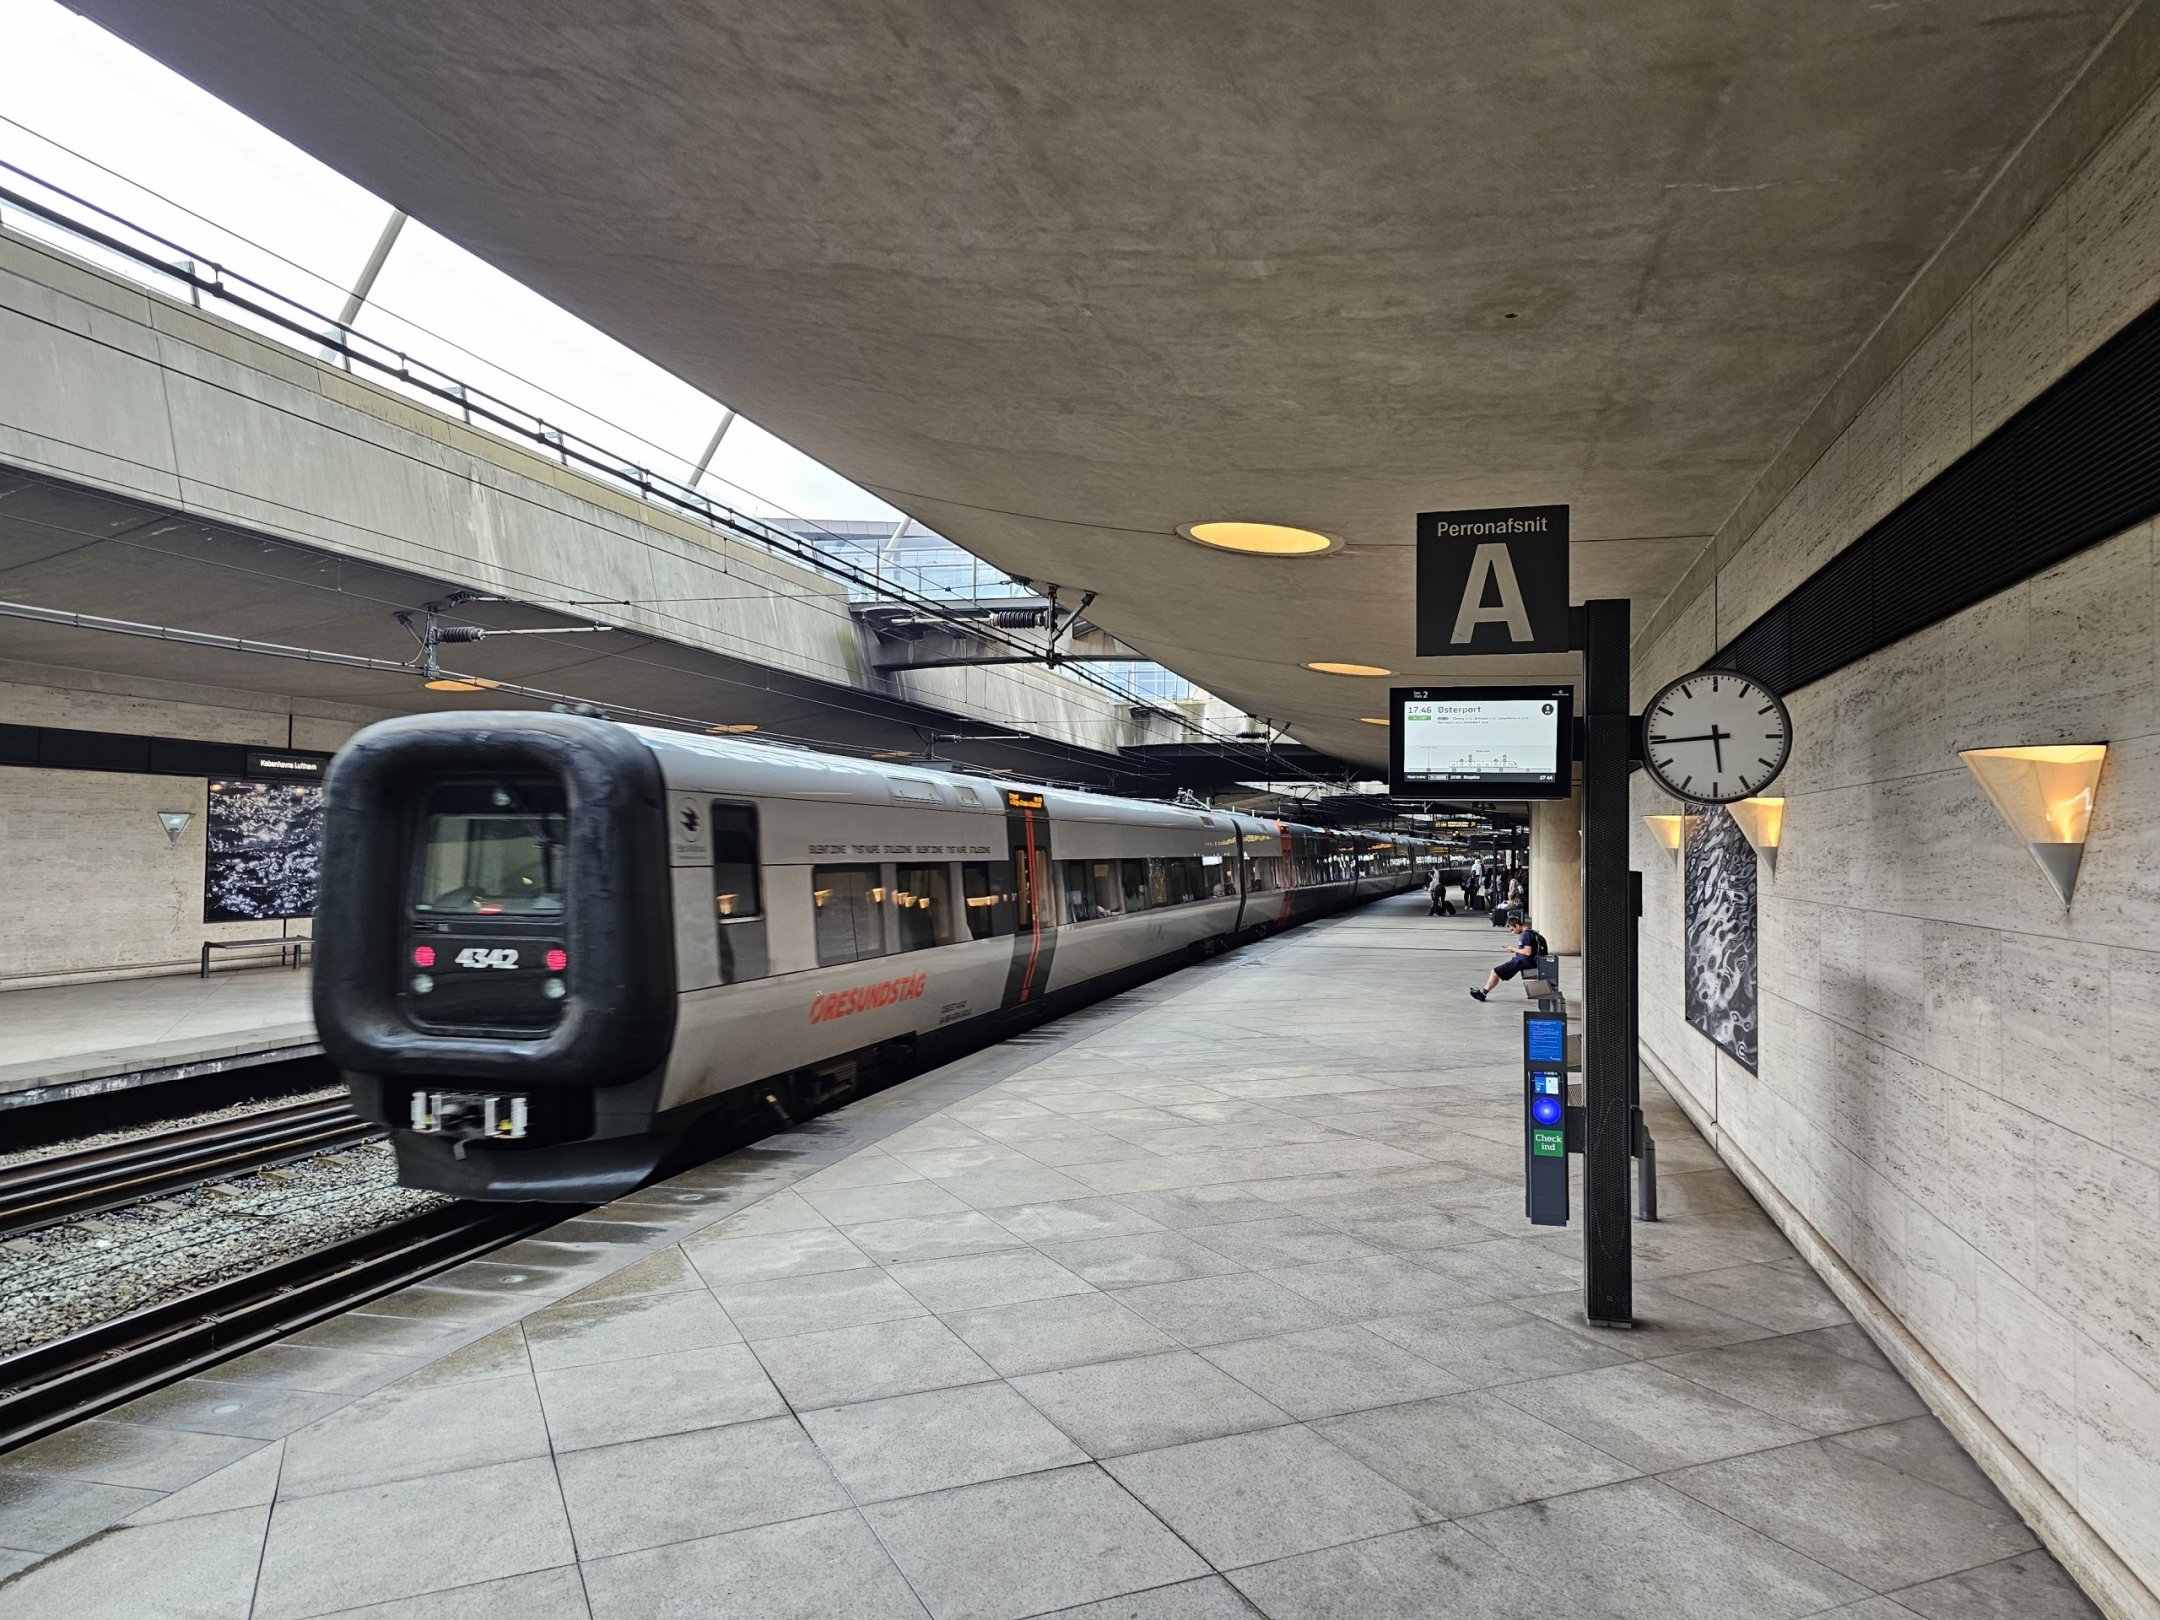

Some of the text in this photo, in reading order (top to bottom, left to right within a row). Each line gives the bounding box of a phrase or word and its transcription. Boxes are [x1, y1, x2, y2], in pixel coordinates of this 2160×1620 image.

[1437, 516, 1548, 537] Perronafsnit
[1450, 543, 1534, 644] A
[1535, 1134, 1562, 1143] Check
[1541, 1142, 1556, 1151] ind
